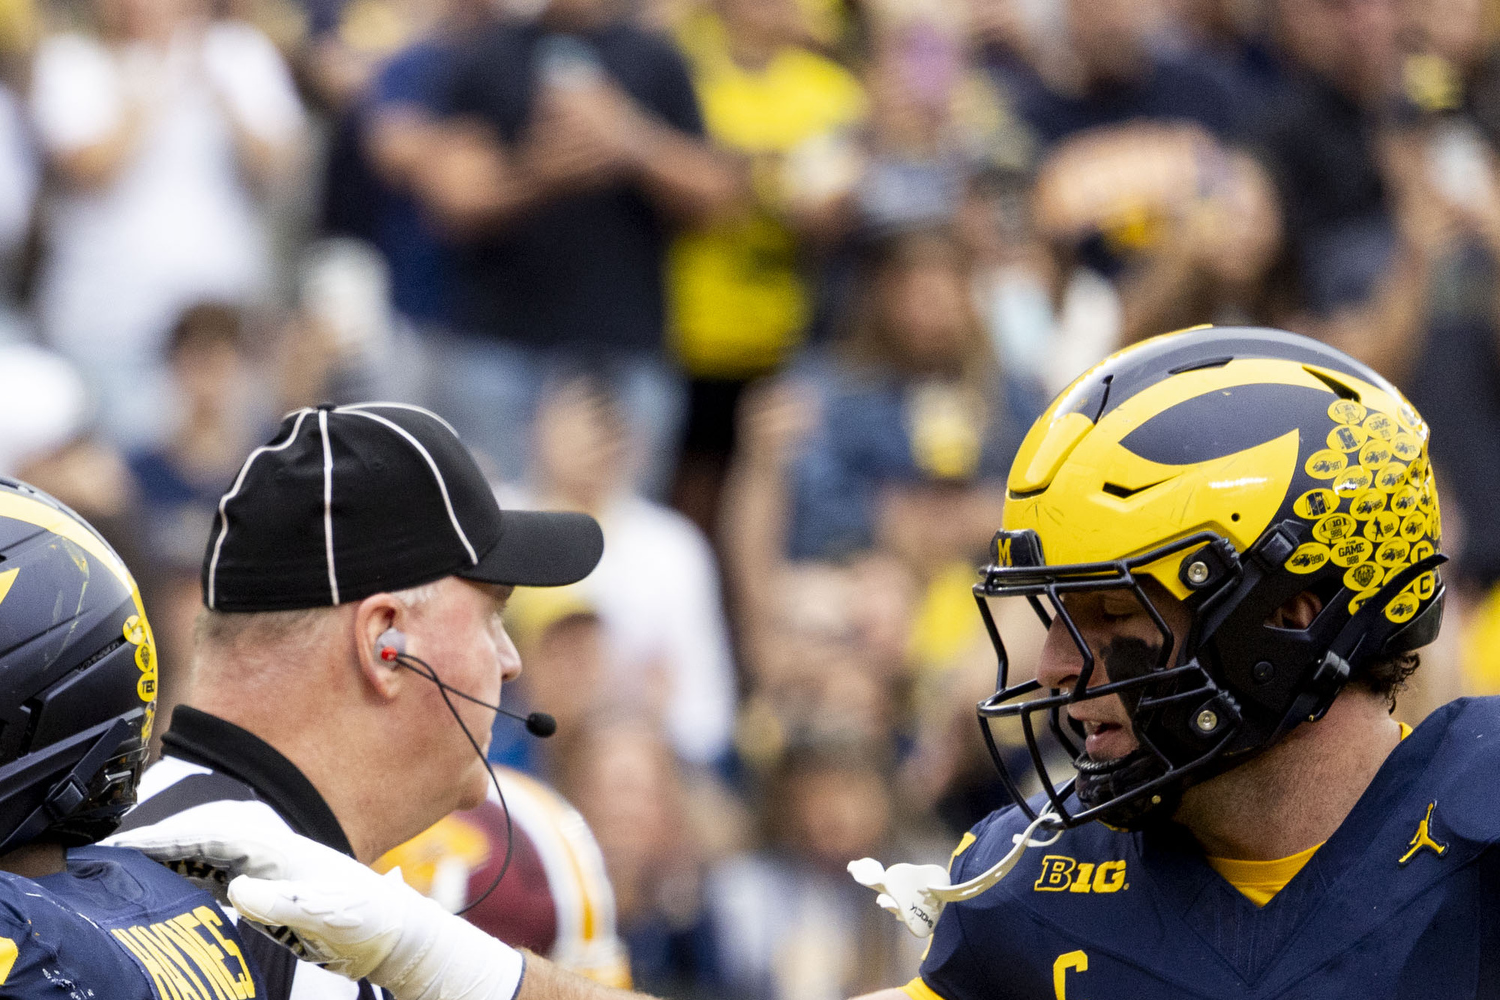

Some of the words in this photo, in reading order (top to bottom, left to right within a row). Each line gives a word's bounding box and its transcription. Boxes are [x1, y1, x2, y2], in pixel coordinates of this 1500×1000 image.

[997, 537, 1013, 567] M
[1338, 542, 1365, 557] GAME
[1420, 575, 1431, 594] C
